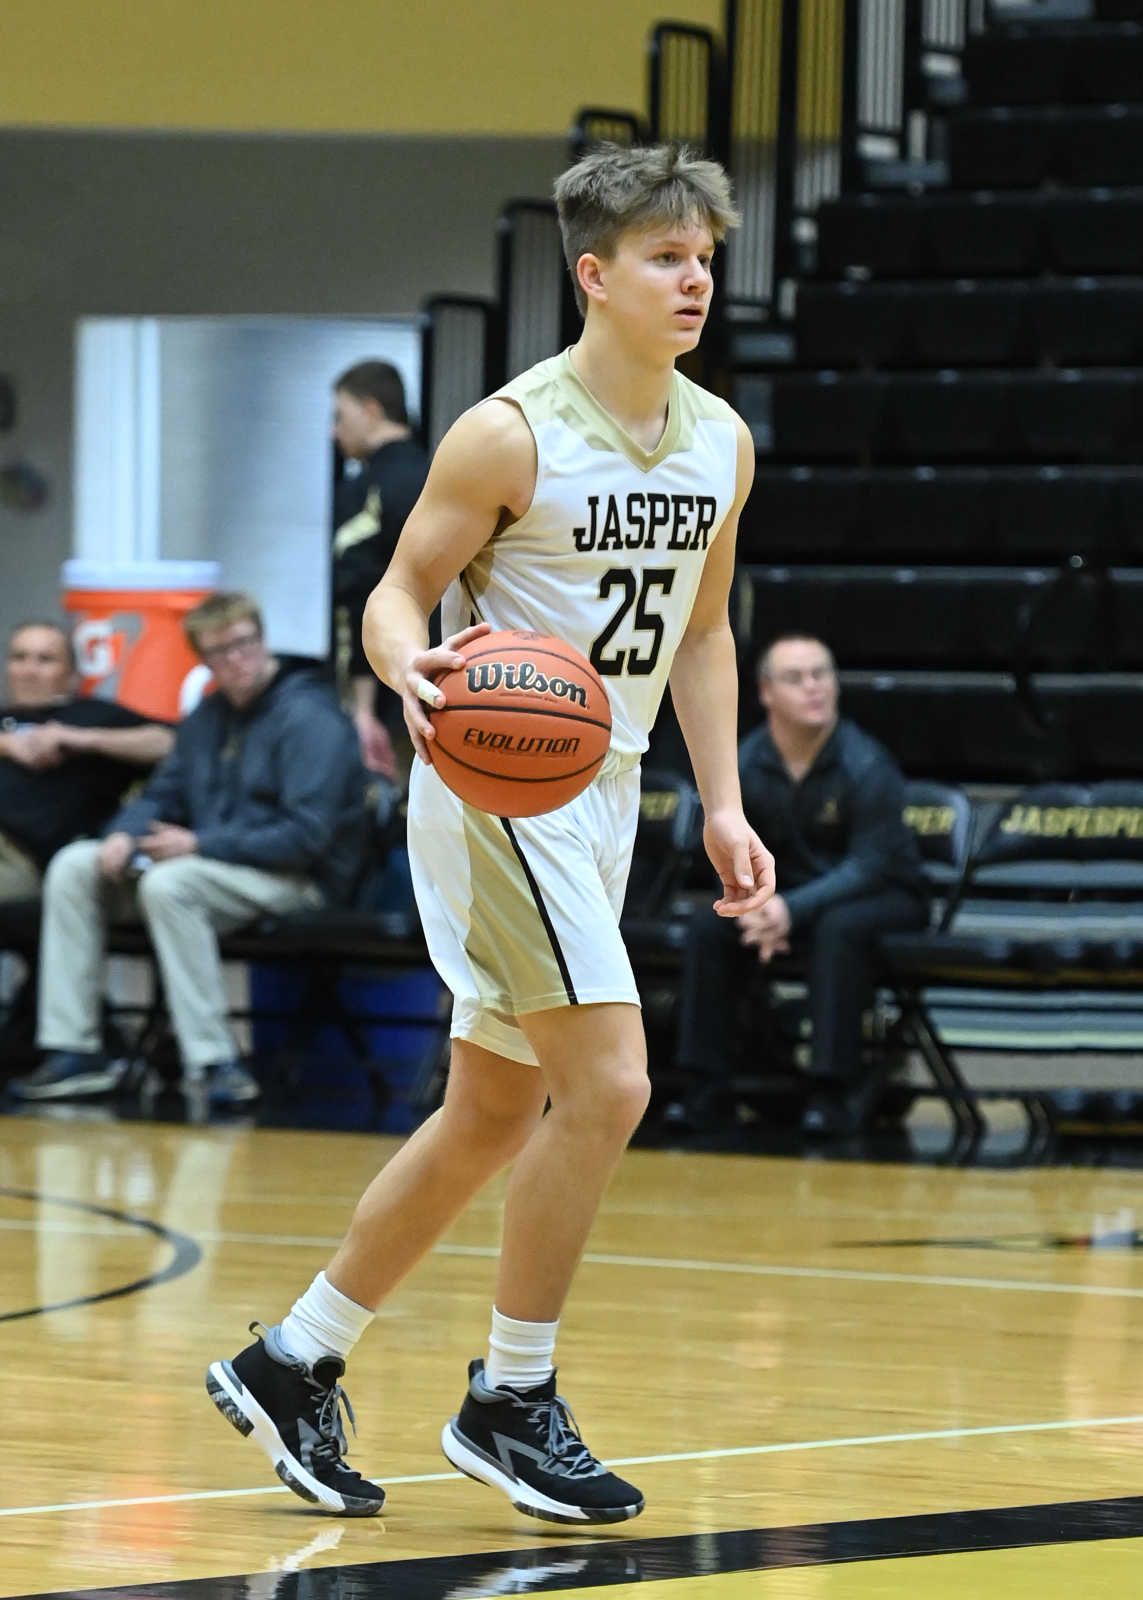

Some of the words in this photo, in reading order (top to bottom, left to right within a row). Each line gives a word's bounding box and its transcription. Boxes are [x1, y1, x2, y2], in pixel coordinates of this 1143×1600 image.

[572, 492, 717, 551] JASPER
[588, 566, 678, 678] 25
[466, 662, 587, 709] Wilson
[463, 727, 580, 756] EVOLUTION
